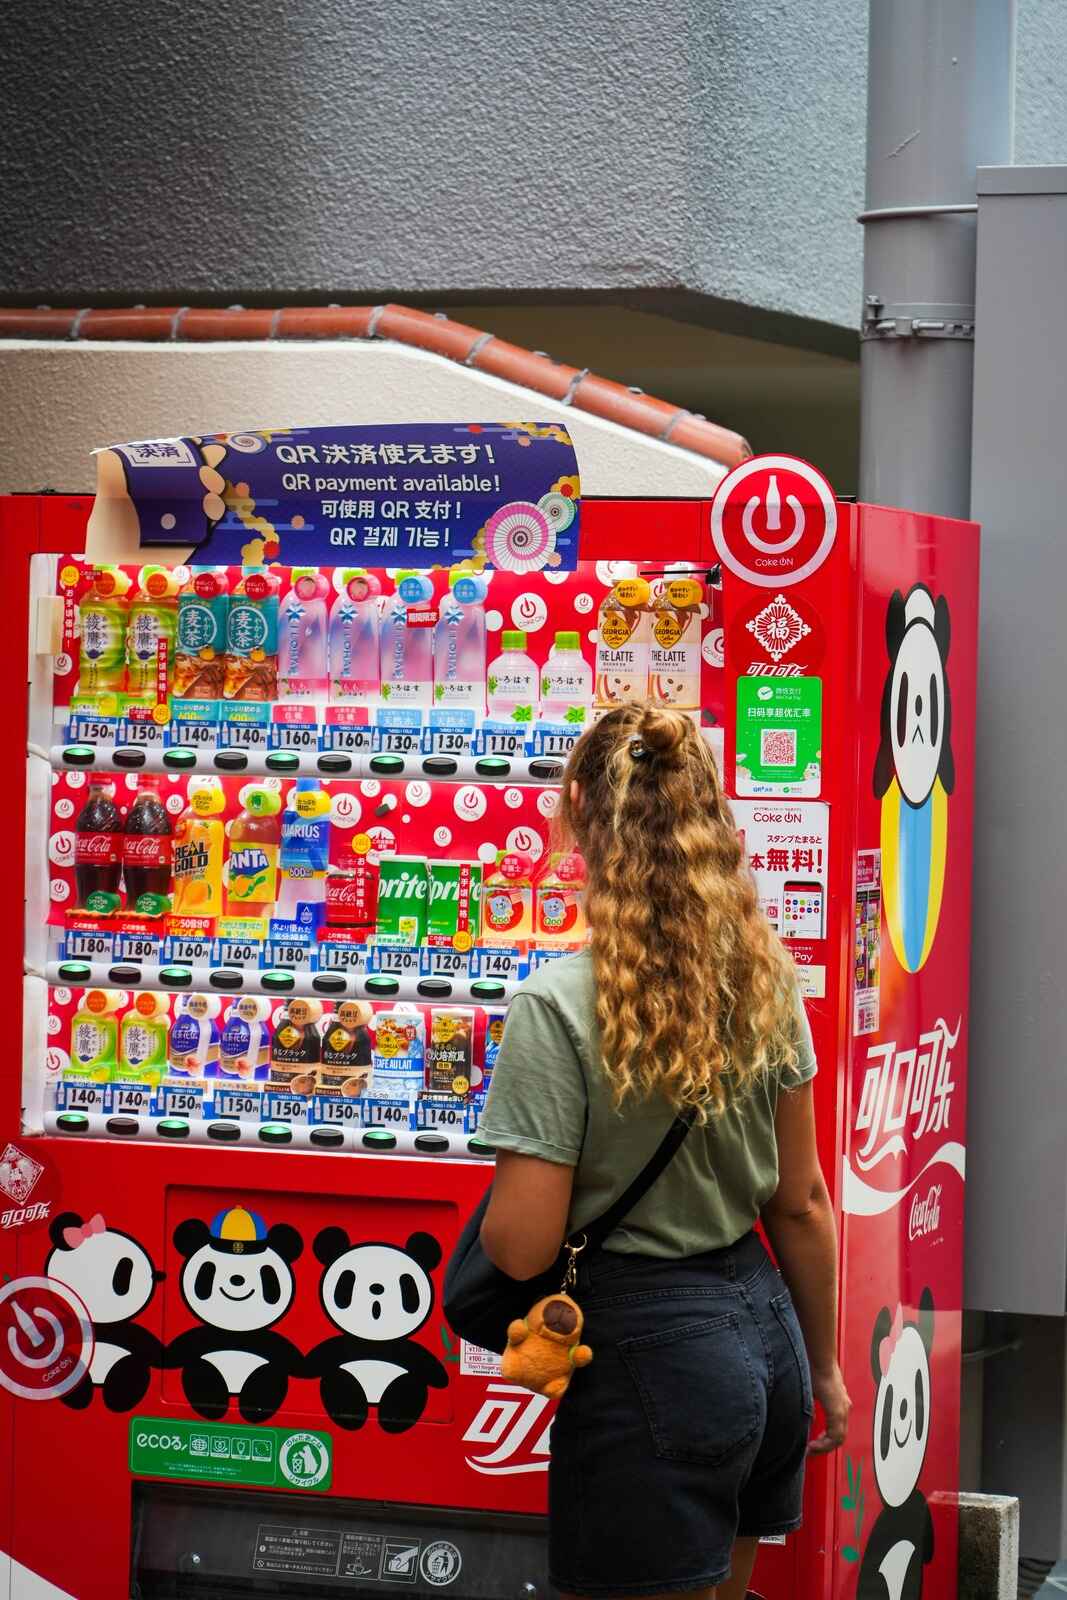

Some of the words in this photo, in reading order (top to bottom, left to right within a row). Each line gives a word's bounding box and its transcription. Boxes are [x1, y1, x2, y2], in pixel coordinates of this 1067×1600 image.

[282, 475, 310, 492] QR
[315, 475, 396, 495] payment
[402, 474, 501, 492] available!
[320, 500, 376, 519] 可使用
[381, 501, 409, 519] QR
[415, 500, 462, 519] 支付!
[329, 528, 355, 547] QR
[363, 526, 398, 547] 결제
[408, 526, 450, 547] 가능!
[755, 557, 778, 567] Coke
[185, 609, 202, 646] 麦茶
[236, 611, 253, 648] 麦茶
[767, 616, 789, 639] 福
[610, 650, 634, 661] LATTE
[663, 650, 686, 662] LATTE
[84, 724, 114, 738] 150円
[132, 726, 162, 740] 150円
[185, 727, 215, 742] 140円
[235, 728, 265, 743] 140円
[285, 731, 317, 746] 160円
[338, 733, 370, 747] 160円
[387, 735, 418, 750] 130円
[438, 735, 469, 750] 130円
[491, 736, 523, 751] 110円
[548, 737, 574, 751] 110
[753, 812, 783, 823] Coke
[784, 811, 802, 823] ON
[281, 823, 320, 839] UARIUS
[767, 834, 823, 844] スタンプたまると
[175, 841, 209, 859] REAL
[175, 854, 209, 873] GOLD
[230, 849, 268, 870] ANTA
[379, 871, 428, 899] prite
[80, 939, 111, 954] 180円
[128, 941, 159, 957] 180円
[178, 942, 209, 958] 160円
[226, 945, 257, 960] 160円
[278, 947, 309, 963] 180円
[333, 950, 365, 966] 150円
[386, 953, 418, 968] 120円
[436, 955, 467, 970] 120円
[486, 956, 518, 971] 140円
[71, 1089, 101, 1103] 140円
[118, 1091, 149, 1106] 140円
[170, 1095, 201, 1110] 150円
[228, 1099, 259, 1113] 150円
[276, 1101, 307, 1117] 150円
[327, 1104, 359, 1119] 150円
[377, 1107, 408, 1122] 140円
[430, 1110, 463, 1124] 140円
